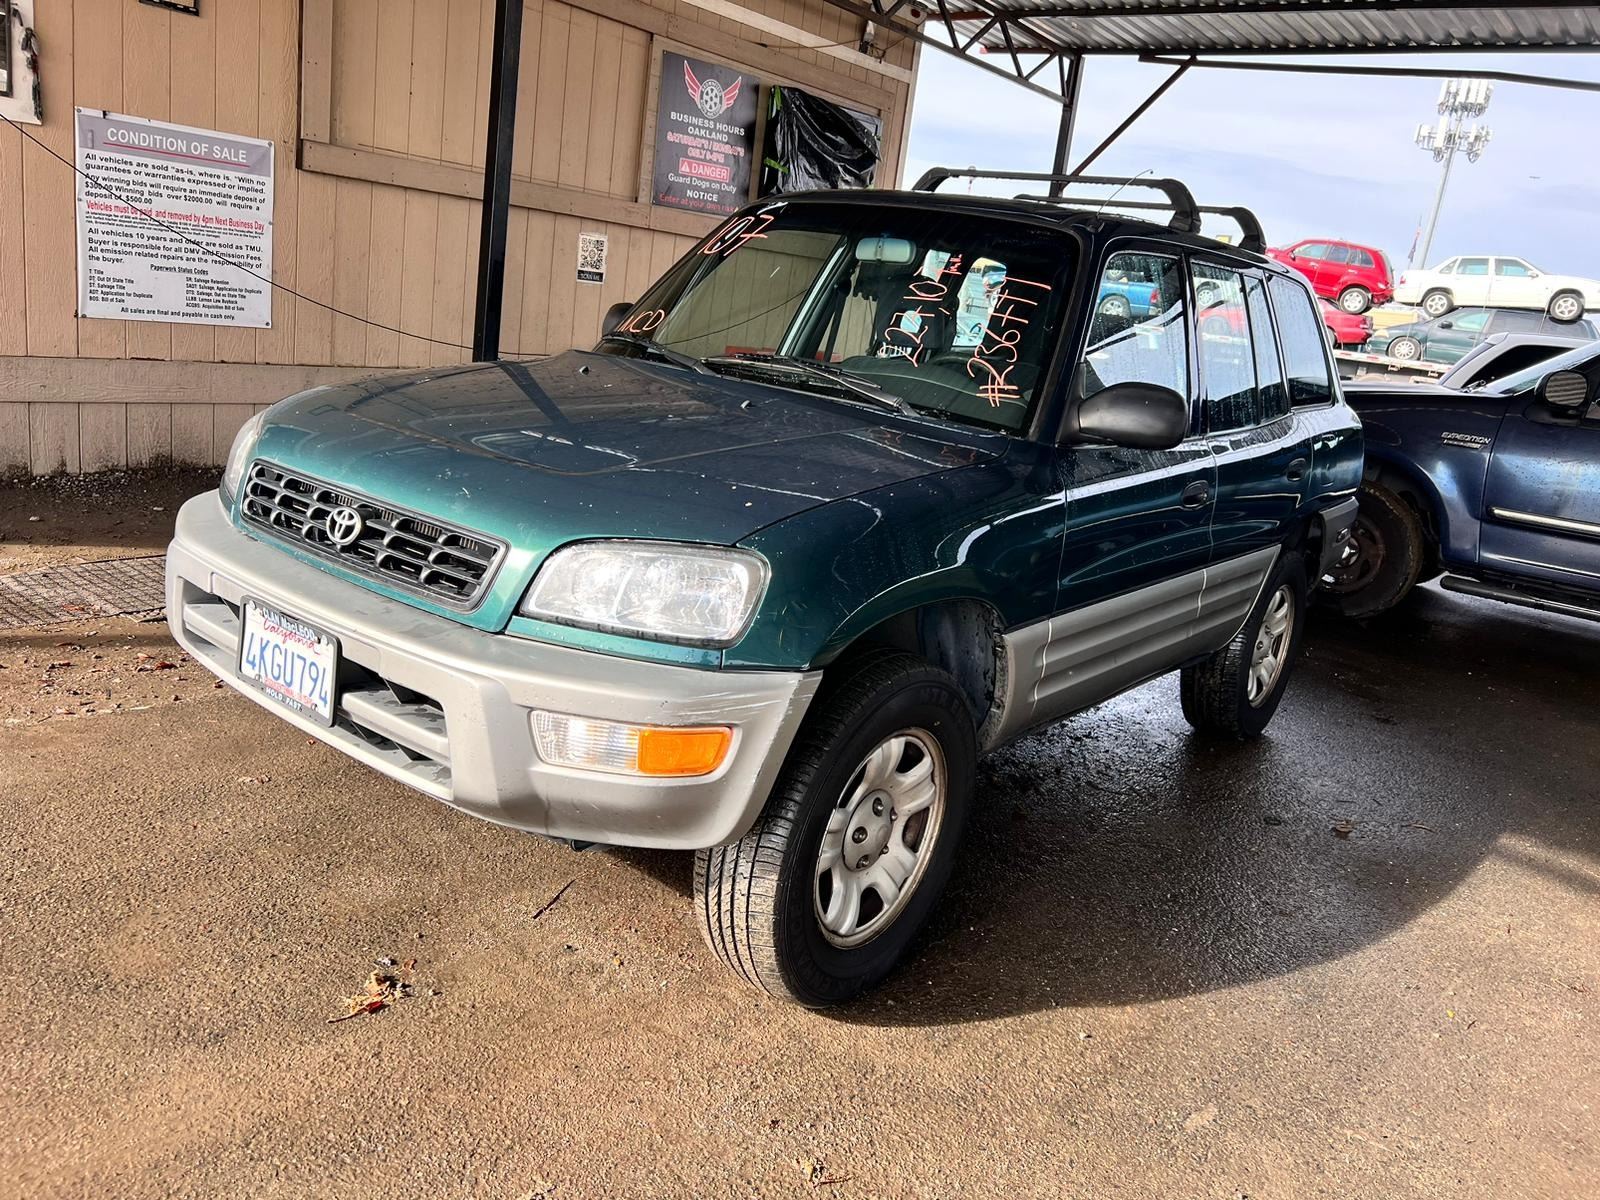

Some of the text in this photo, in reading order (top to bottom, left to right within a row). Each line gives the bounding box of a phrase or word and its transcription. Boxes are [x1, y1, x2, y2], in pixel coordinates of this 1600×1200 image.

[670, 111, 745, 136] BUSINESS HOURS
[107, 128, 246, 162] CONDITION OF SALE
[688, 127, 728, 142] OAKLAND
[99, 155, 133, 166] vehicles
[198, 171, 220, 179] where
[691, 164, 727, 179] DANGER
[85, 162, 131, 174] guarantees
[144, 171, 185, 183] warranties
[188, 177, 226, 188] expressed
[238, 184, 265, 194] implied.
[85, 173, 100, 181] Any
[102, 175, 130, 186] winning
[163, 184, 187, 193] require
[199, 190, 232, 200] immediate
[234, 194, 257, 203] deposit
[668, 173, 736, 194] Guard Dogs on Duty
[85, 191, 112, 201] deposit
[126, 195, 152, 204] $500.00
[115, 186, 144, 196] Winning
[148, 190, 163, 198] bids
[184, 195, 212, 204] $2000.00
[230, 201, 252, 210] require
[660, 194, 679, 203] Enter
[686, 190, 718, 201] NOTICE
[86, 200, 112, 212] Vehicles
[114, 204, 129, 214] must
[168, 211, 192, 221] removed
[194, 214, 200, 222] by
[202, 215, 214, 224] 4pm
[215, 217, 227, 225] Next
[229, 218, 253, 230] Business
[255, 221, 264, 232] Day
[101, 230, 133, 238] vehicles
[88, 237, 110, 246] Buyer
[120, 241, 161, 251] responsible
[216, 251, 244, 260] Emission
[100, 248, 133, 256] emission
[135, 250, 158, 258] related
[212, 259, 253, 269] responsibility
[102, 256, 124, 264] buyer.
[151, 263, 176, 272] Paperwork
[1441, 432, 1491, 444] EXPEDITION
[246, 632, 327, 708] 4KGU794
[266, 687, 282, 701] HOLD
[286, 697, 301, 711] FAST
